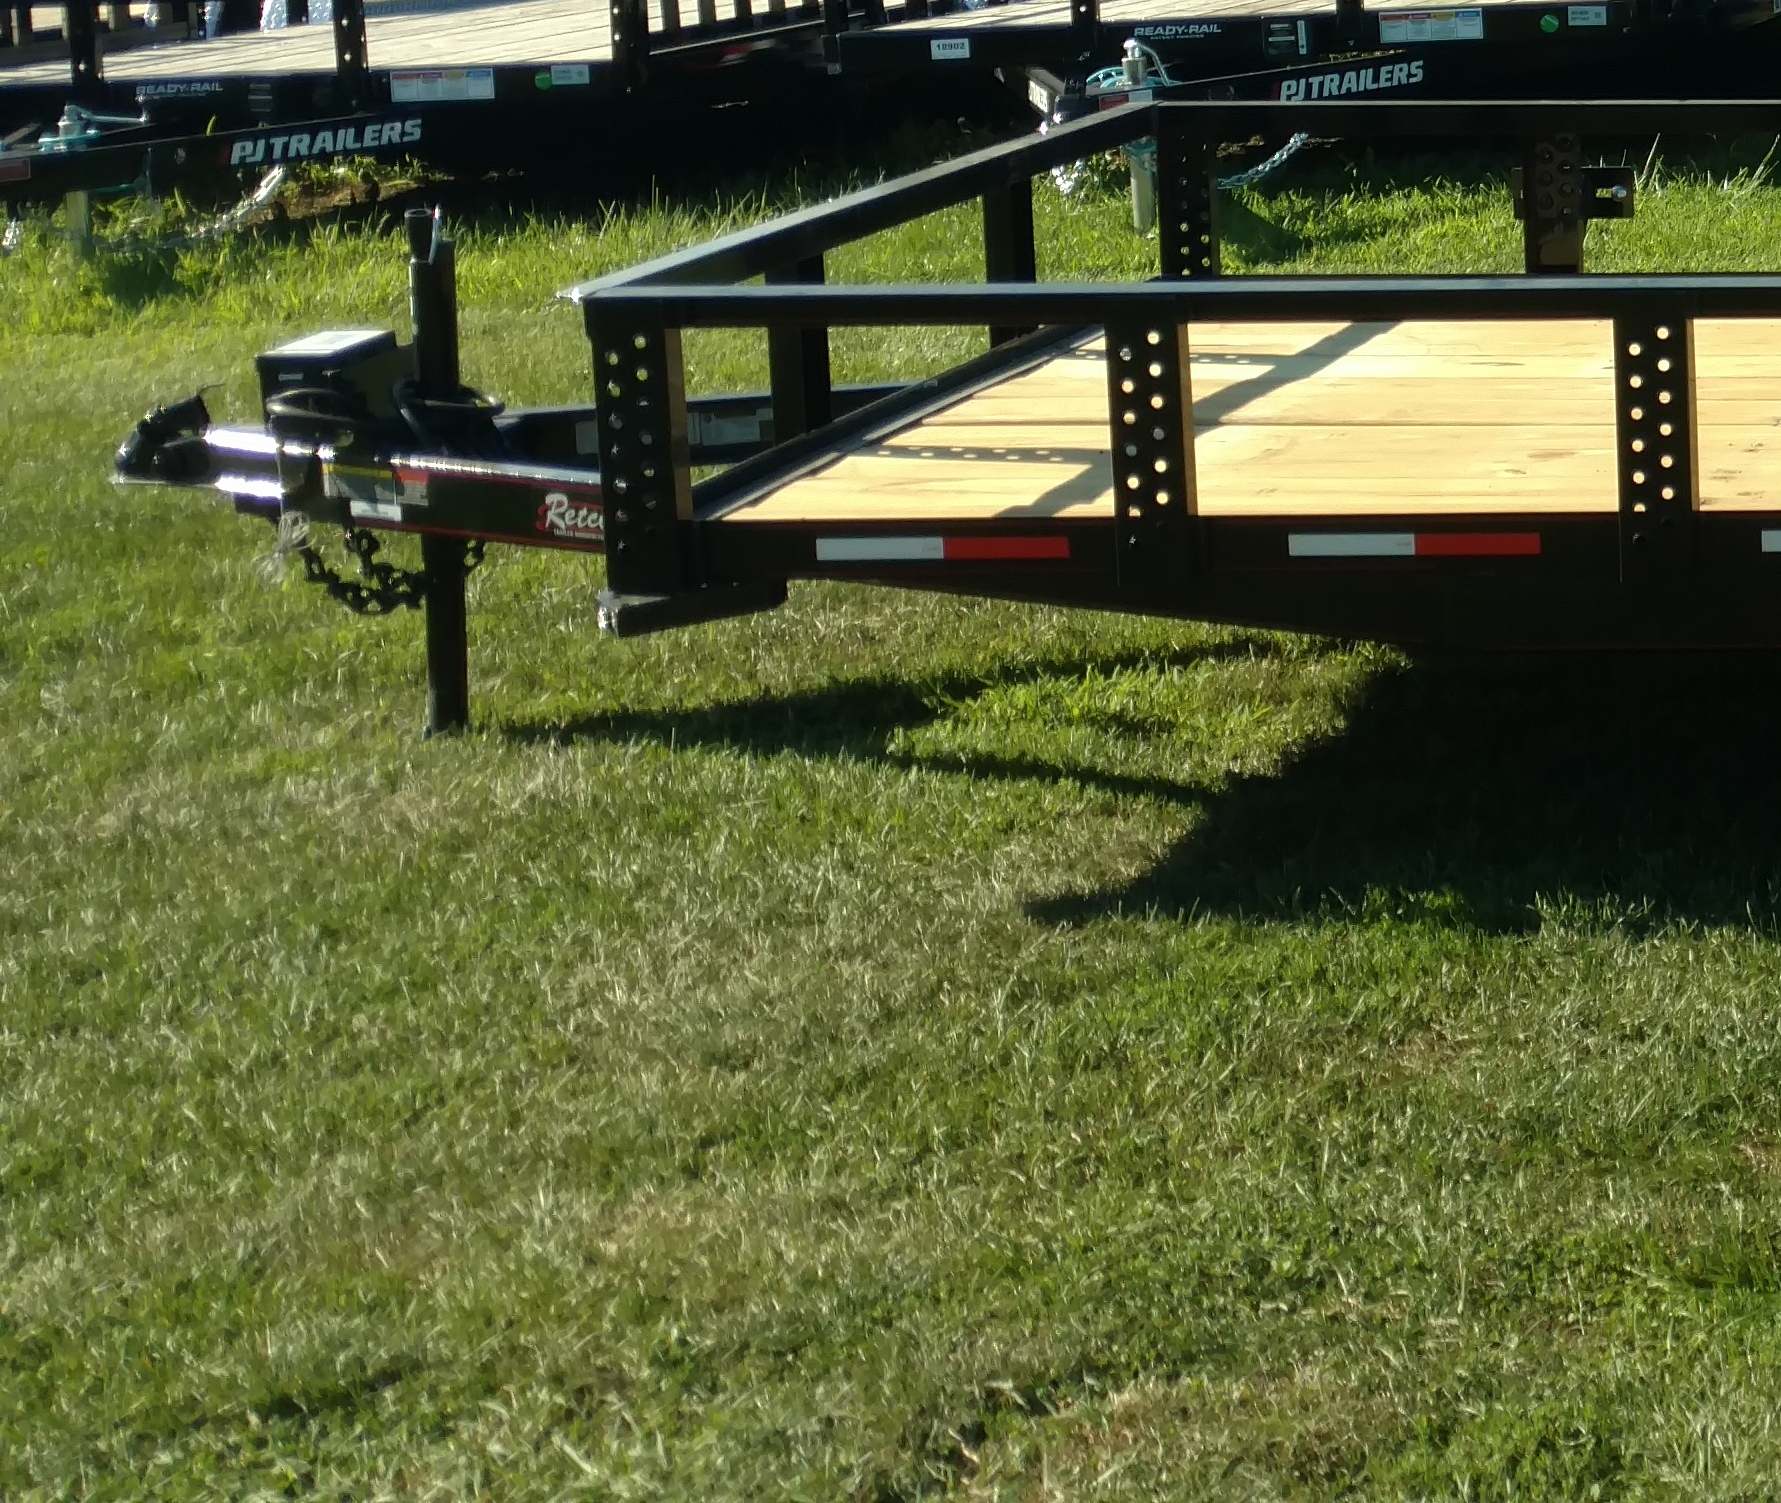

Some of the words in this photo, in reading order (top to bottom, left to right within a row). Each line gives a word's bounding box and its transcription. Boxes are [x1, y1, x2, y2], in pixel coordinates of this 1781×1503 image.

[1280, 78, 1306, 102] PJ
[1308, 60, 1424, 99] TRAILERS
[230, 139, 266, 165] PJ
[269, 118, 422, 160] TRAILERS
